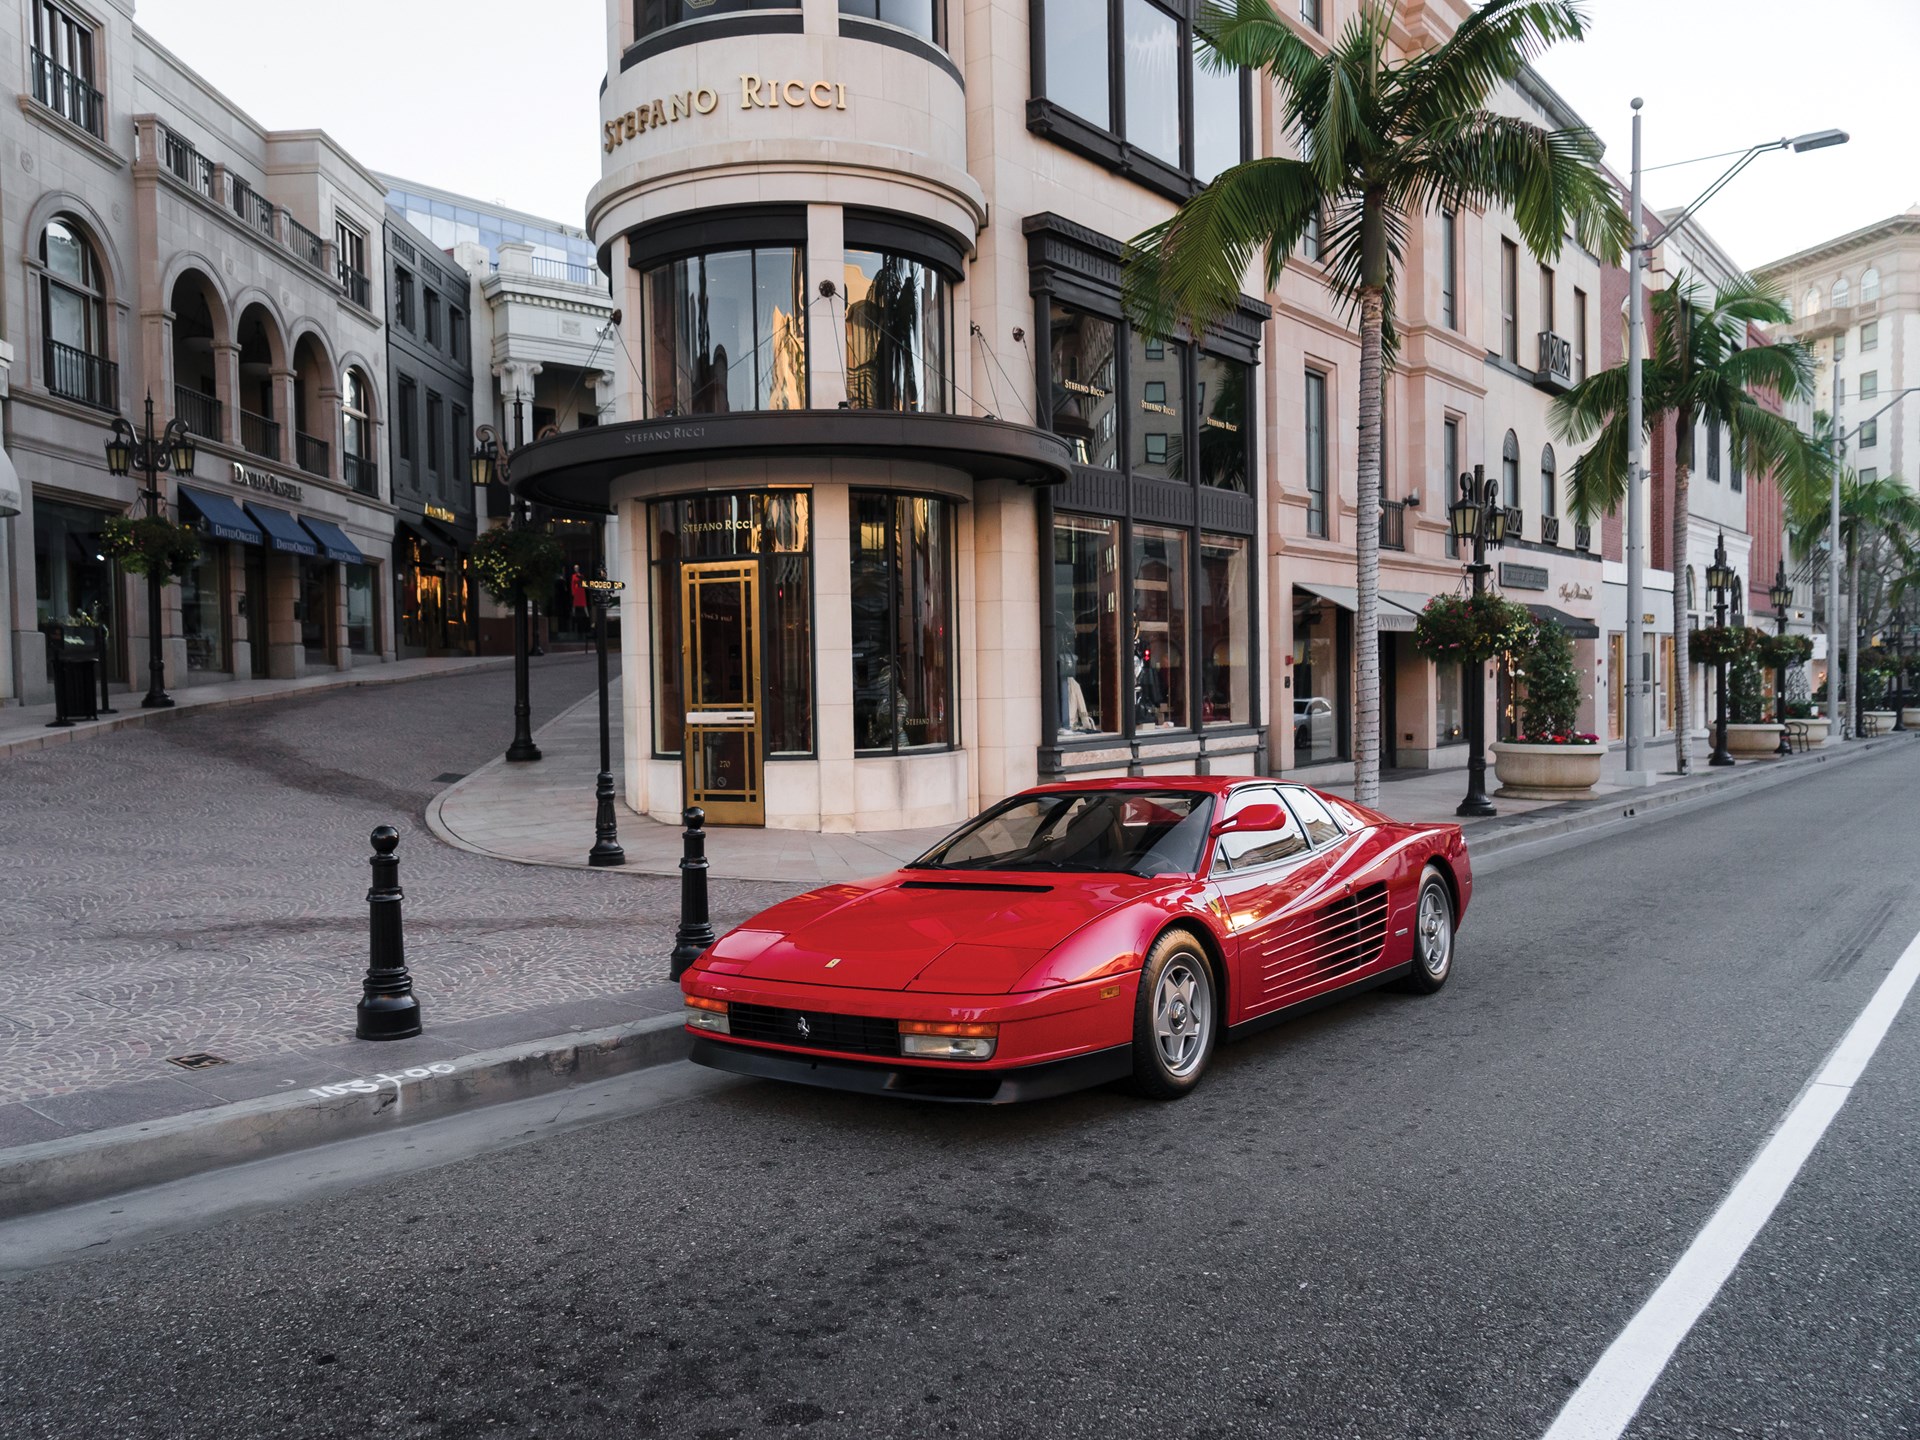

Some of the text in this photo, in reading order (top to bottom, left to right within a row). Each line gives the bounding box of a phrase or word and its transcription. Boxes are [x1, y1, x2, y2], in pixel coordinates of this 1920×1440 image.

[603, 73, 848, 154] STEFANO RICCI
[1064, 379, 1089, 393] STEFANO
[624, 427, 705, 444] STEFANO RICCI
[682, 522, 723, 534] STEFANO
[589, 580, 612, 589] RODEO
[613, 581, 623, 589] DR
[719, 760, 731, 769] 270
